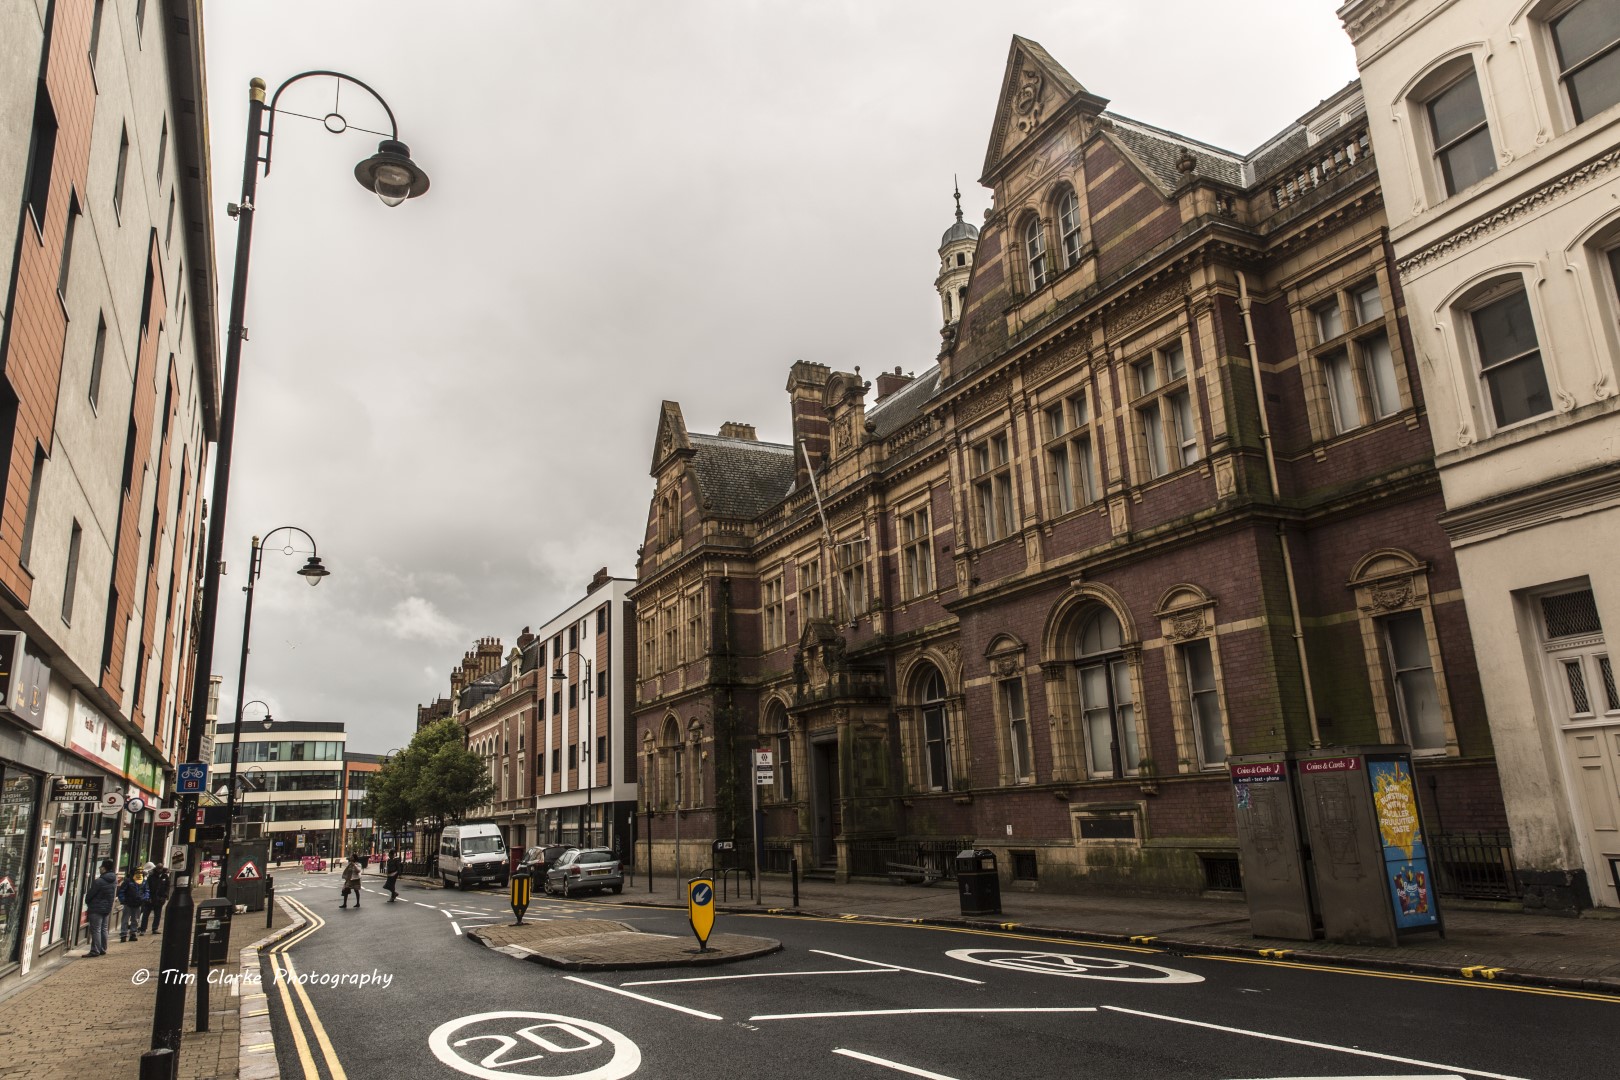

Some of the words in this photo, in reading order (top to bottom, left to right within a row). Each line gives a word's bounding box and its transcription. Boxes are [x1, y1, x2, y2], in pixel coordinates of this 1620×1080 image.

[1236, 767, 1250, 775] Coins
[1256, 765, 1272, 774] Cards
[1306, 762, 1322, 771] Coins
[1328, 760, 1346, 769] Cards
[1385, 784, 1399, 793] NOW
[1380, 792, 1409, 805] BURSTING
[1386, 800, 1401, 809] WITH
[1392, 825, 1410, 834] TASTE
[454, 1022, 603, 1068] 20
